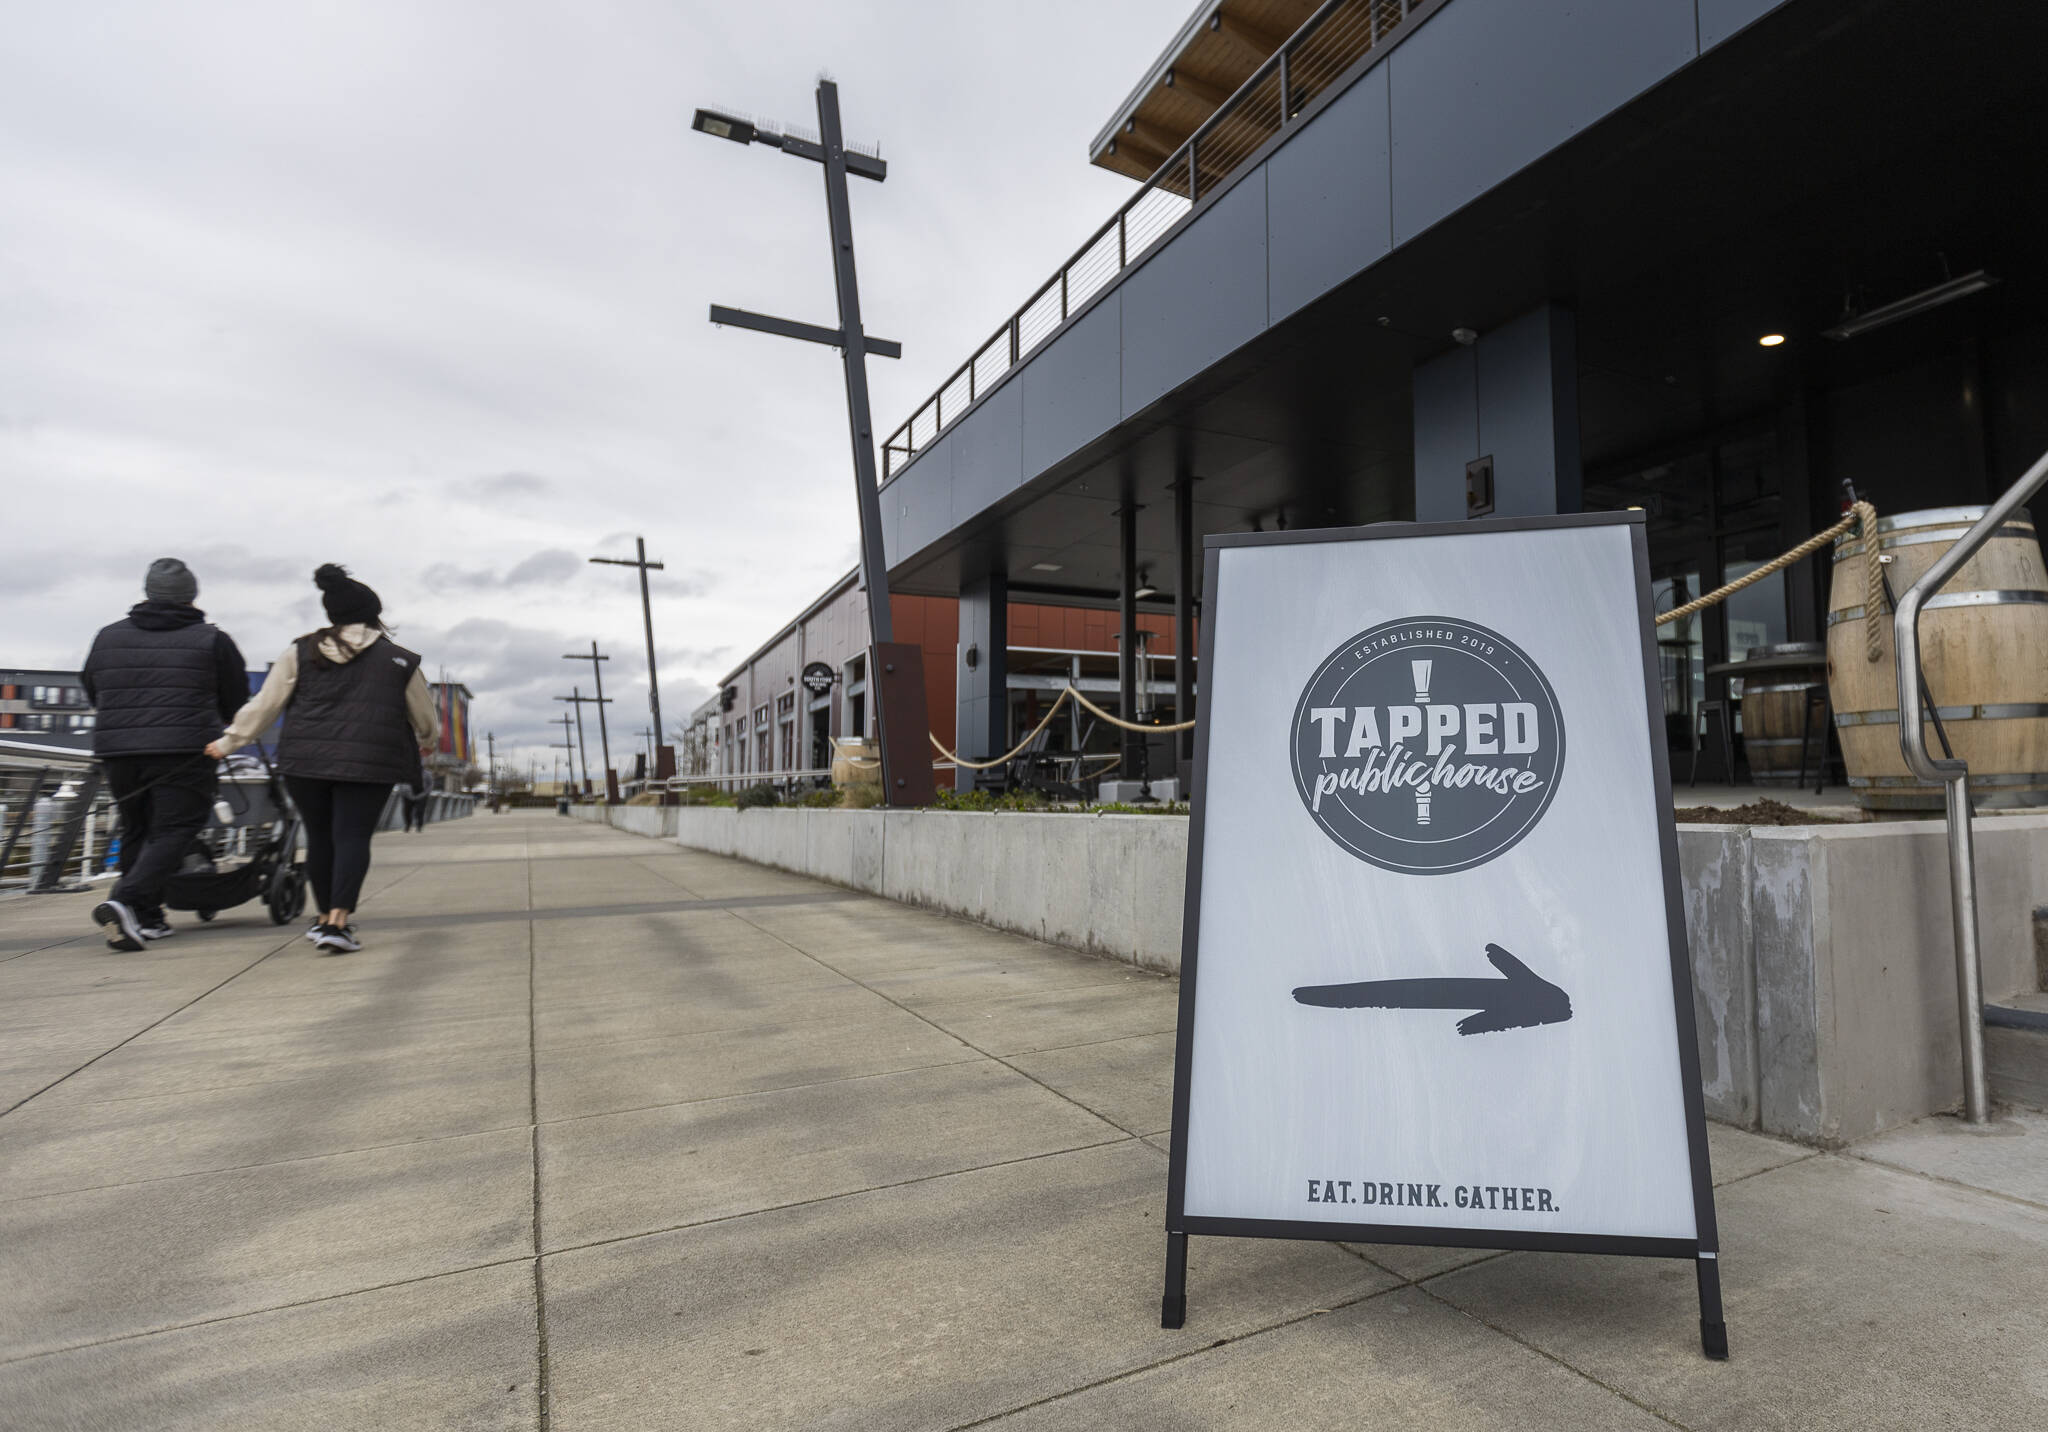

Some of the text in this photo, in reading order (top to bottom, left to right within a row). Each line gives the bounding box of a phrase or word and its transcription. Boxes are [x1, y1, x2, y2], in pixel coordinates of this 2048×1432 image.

[1355, 630, 1494, 659] ESTABLISHED 2019
[1310, 702, 1539, 757] TAPPED
[1307, 1180, 1560, 1212] EAT. DRINK. GATHER.
